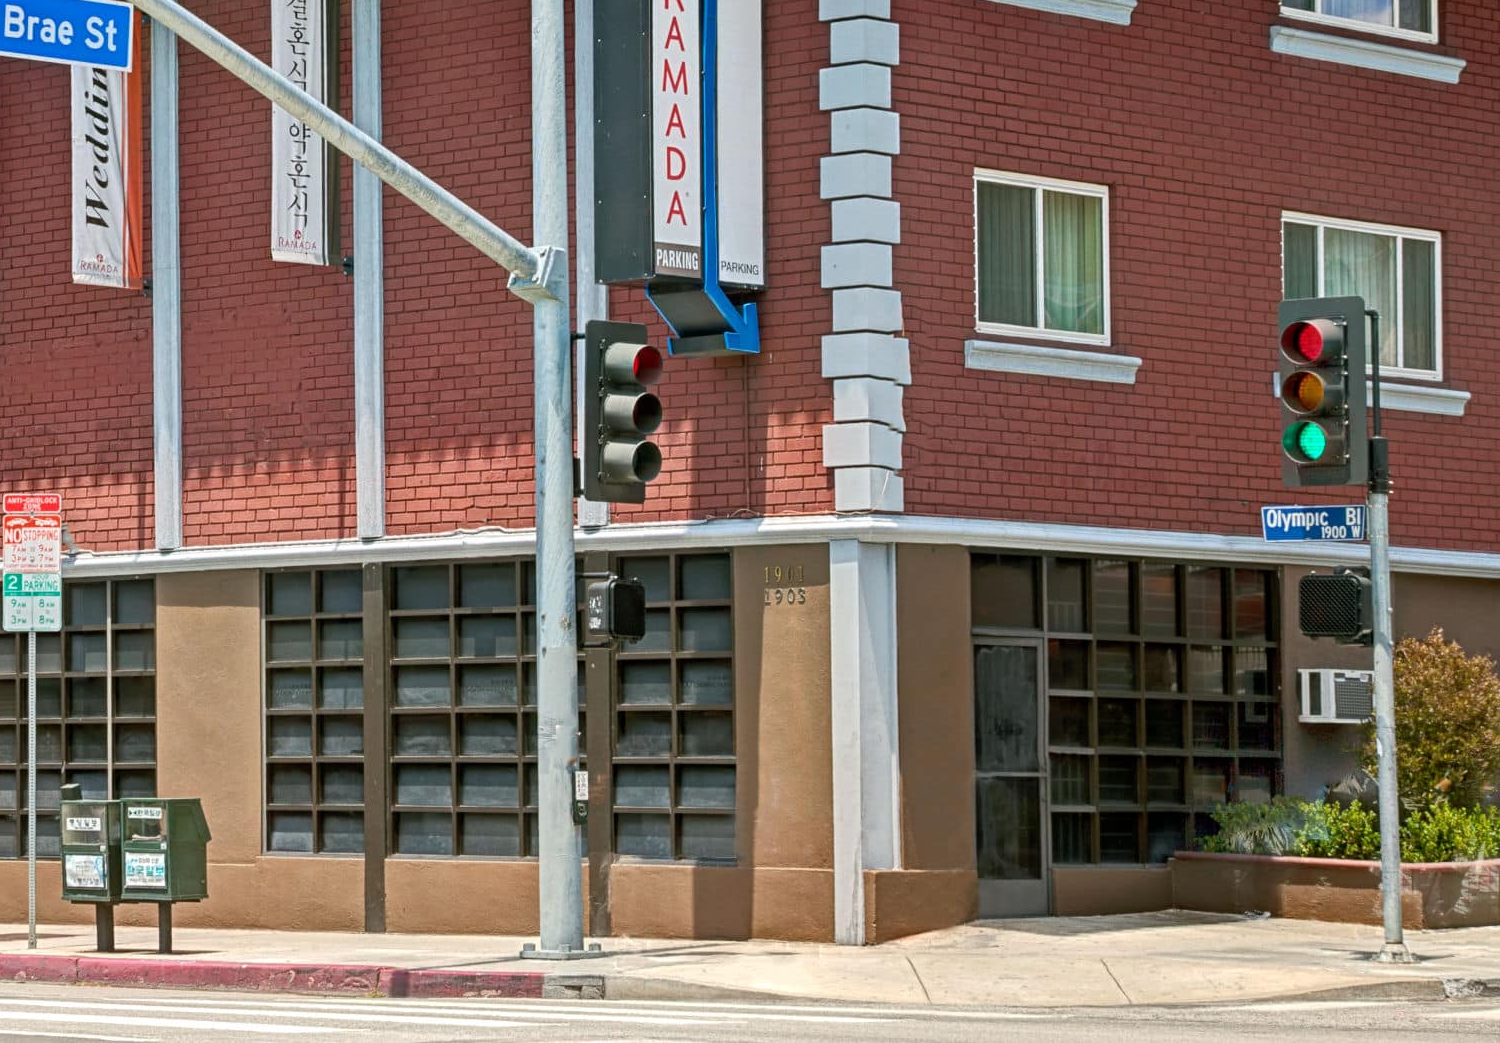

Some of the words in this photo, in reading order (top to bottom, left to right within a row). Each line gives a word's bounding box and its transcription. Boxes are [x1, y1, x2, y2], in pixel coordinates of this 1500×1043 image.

[4, 4, 75, 46] Brae
[84, 15, 118, 53] St
[84, 67, 111, 230] Weddin
[279, 236, 317, 251] RAMADA
[80, 260, 118, 273] RAMADA
[656, 248, 699, 270] PARKING
[720, 261, 759, 275] PARKING
[1266, 509, 1329, 532] Olympic
[4, 528, 21, 543] NO
[23, 529, 59, 541] STOPPING
[1321, 525, 1347, 539] 1900
[1351, 525, 1361, 538] W
[8, 575, 18, 590] 2
[24, 581, 58, 590] PARKING
